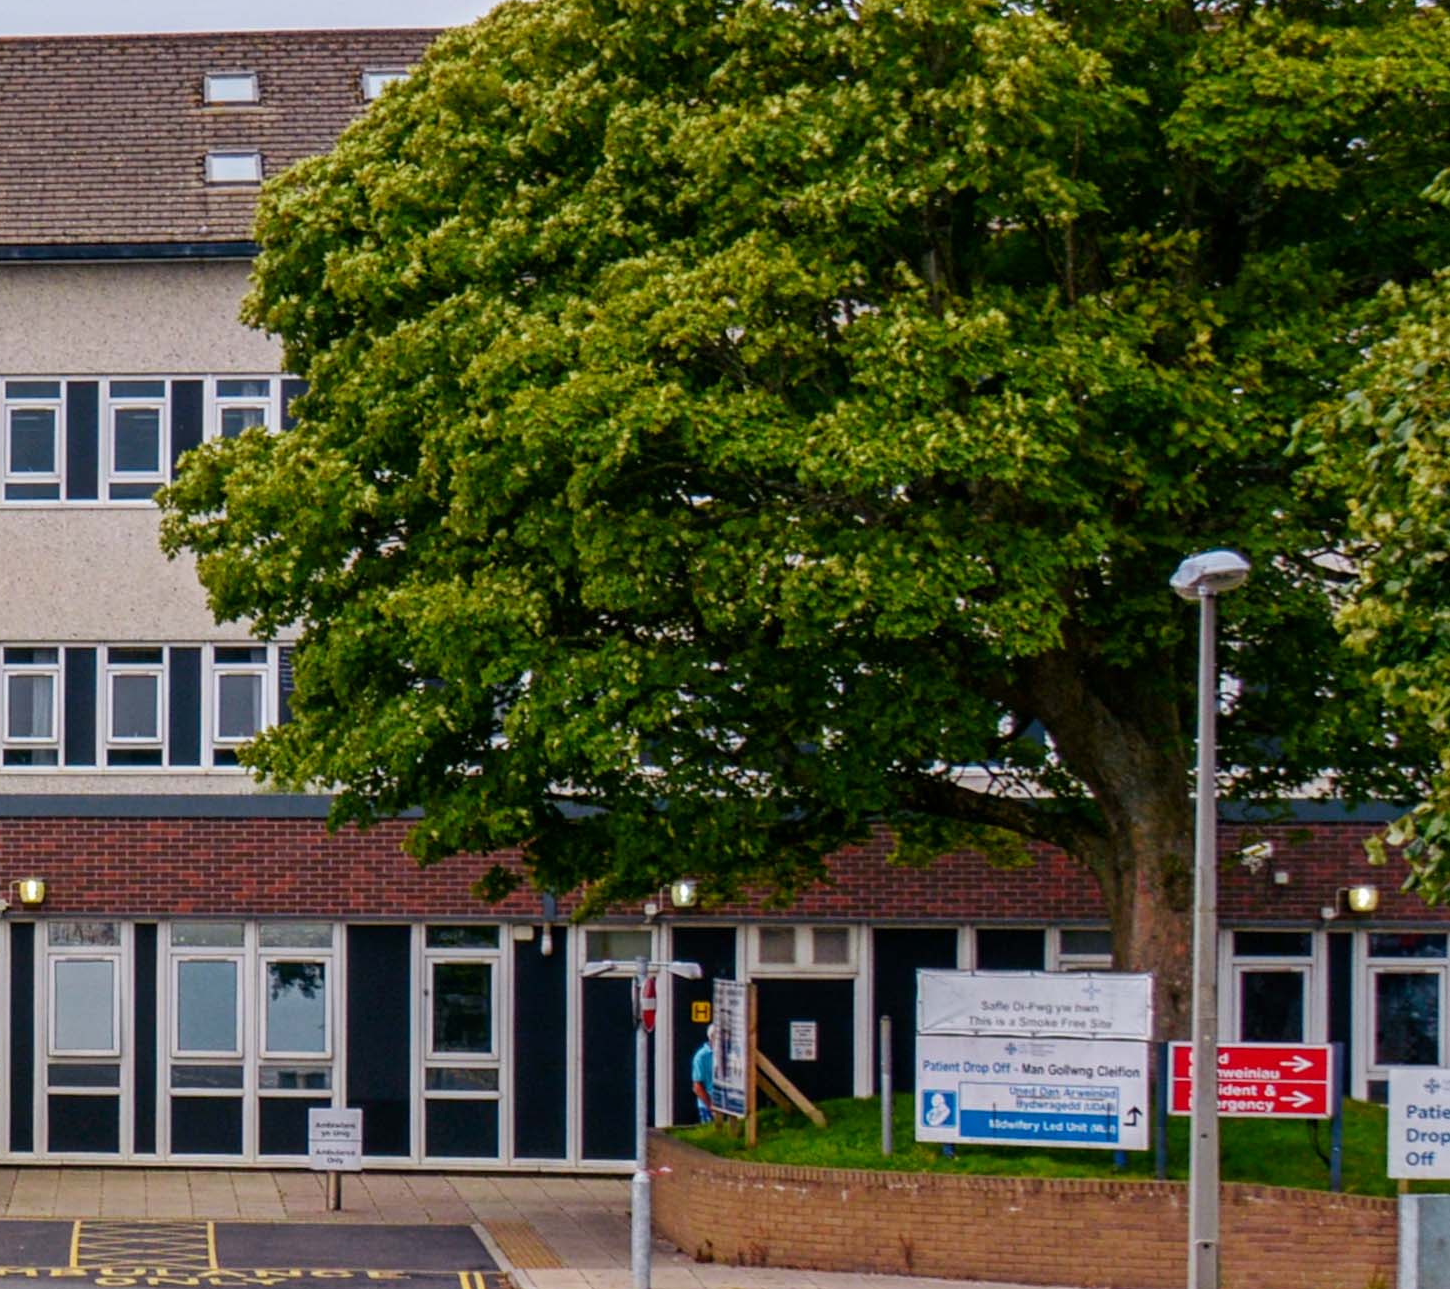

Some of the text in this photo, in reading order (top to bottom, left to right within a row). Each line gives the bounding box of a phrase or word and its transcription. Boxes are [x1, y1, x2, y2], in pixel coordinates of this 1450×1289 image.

[968, 1015, 992, 1027] This
[995, 1015, 1006, 1027] is
[1018, 1016, 1058, 1028] Smoke
[1061, 1017, 1087, 1029] Free
[1090, 1017, 1113, 1030] Site
[922, 1060, 961, 1072] Patient
[963, 1062, 990, 1075] Drop
[992, 1062, 1011, 1074] Off
[1021, 1063, 1045, 1076] Man
[1048, 1064, 1094, 1079] Gollwng
[1264, 1084, 1277, 1097] &
[1406, 1104, 1450, 1120] Patie
[1044, 1119, 1064, 1132] Led
[1065, 1120, 1088, 1133] Unit
[1406, 1127, 1450, 1146] Drop
[1405, 1151, 1436, 1166] Off
[94, 1275, 287, 1287] ONLY
